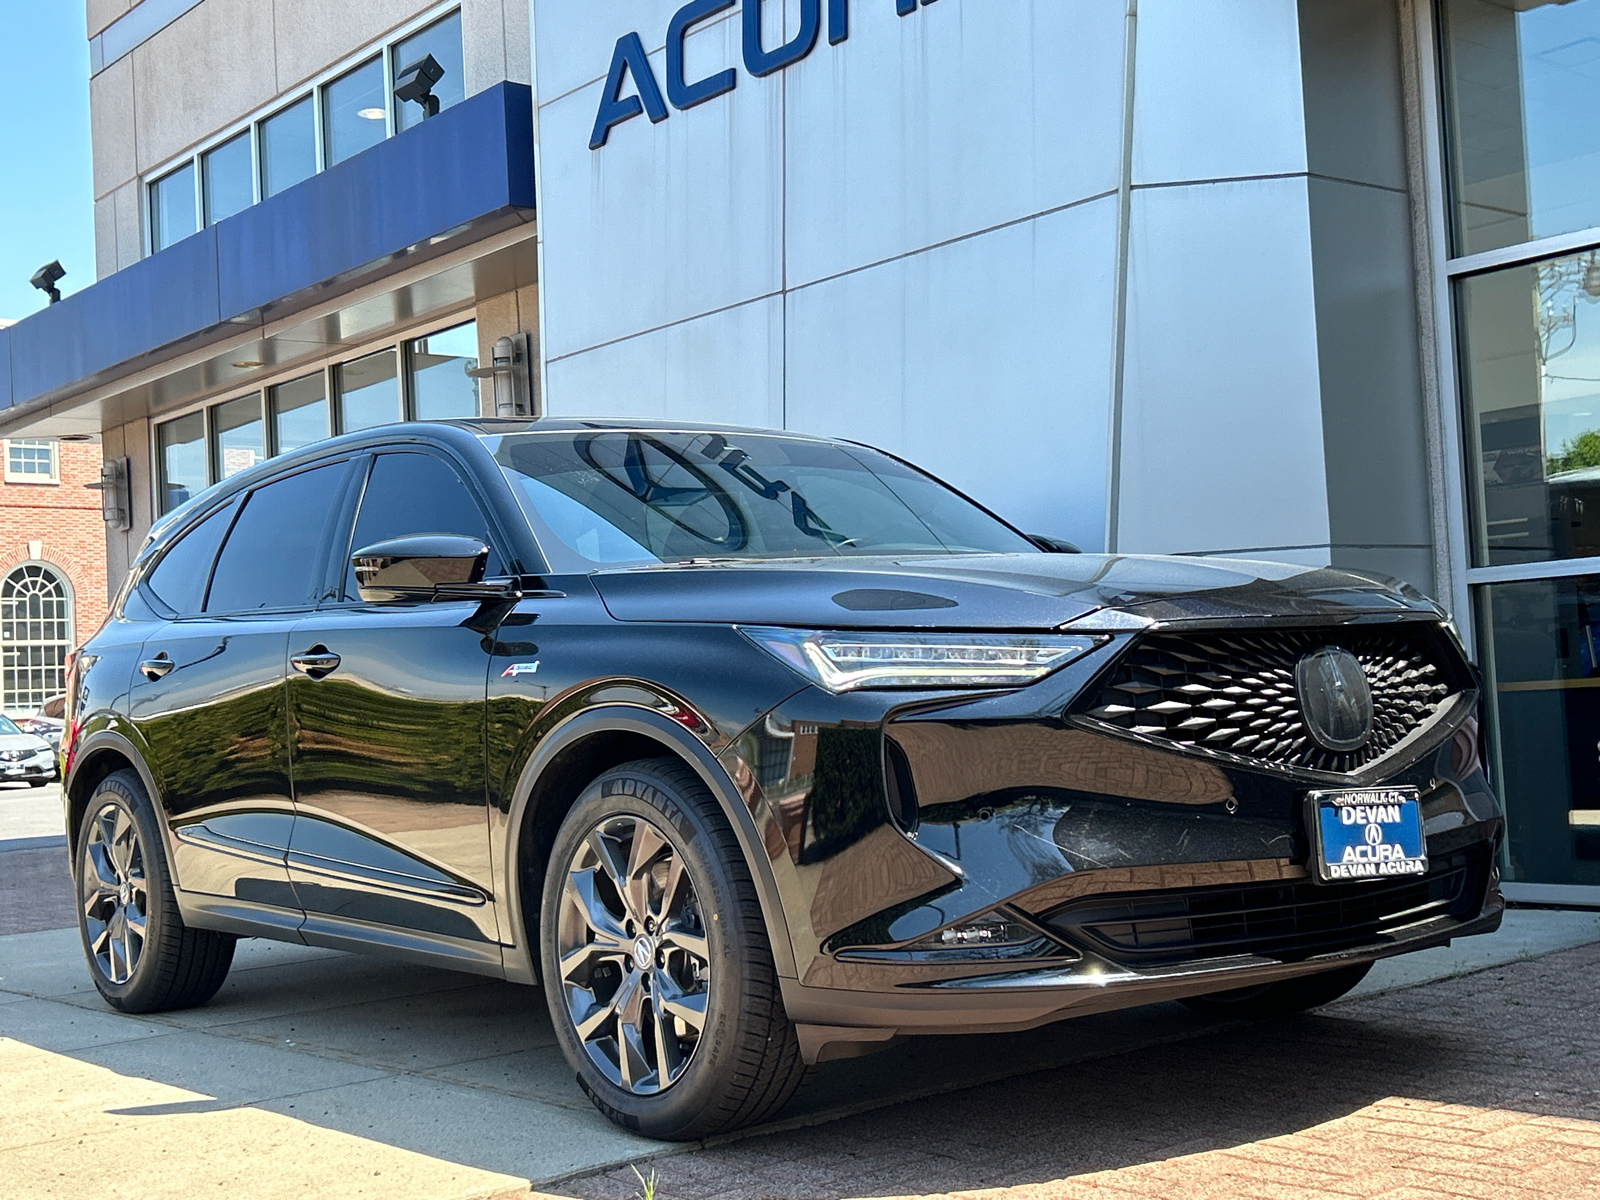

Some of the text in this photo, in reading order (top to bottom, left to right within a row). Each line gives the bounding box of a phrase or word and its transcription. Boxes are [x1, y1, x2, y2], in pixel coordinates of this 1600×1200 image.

[588, 0, 938, 150] ACU
[610, 779, 684, 832] ADVANTA
[1388, 792, 1399, 804] CT
[1341, 805, 1401, 825] DEVAN
[1341, 843, 1406, 863] ACURA
[1330, 860, 1425, 878] DEVAN ACURA
[723, 943, 731, 957] XL
